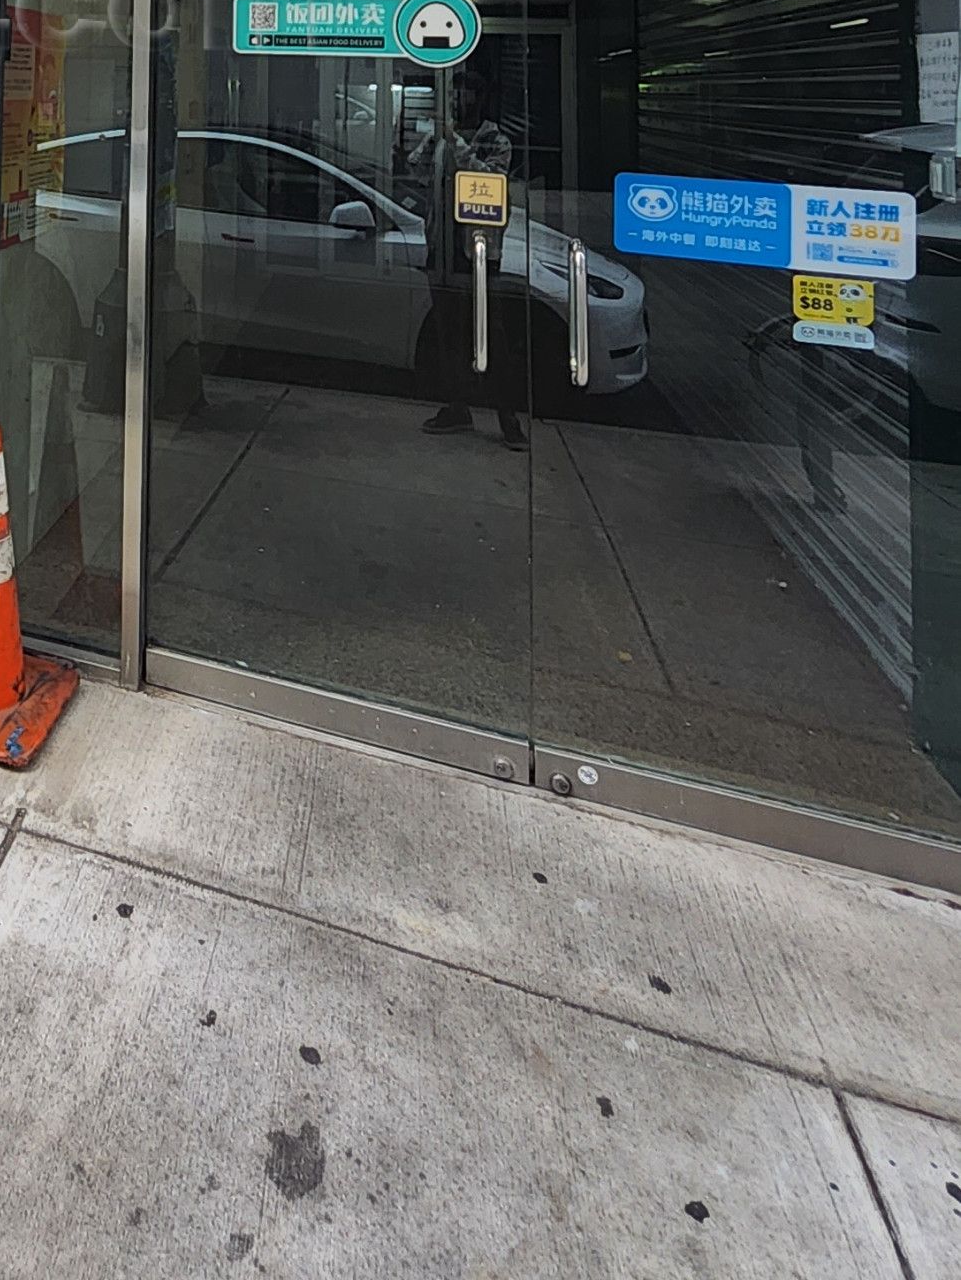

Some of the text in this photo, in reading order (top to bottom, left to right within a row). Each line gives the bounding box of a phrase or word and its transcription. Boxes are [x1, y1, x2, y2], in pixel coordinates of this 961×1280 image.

[286, 3, 385, 25] 饭团外卖
[336, 27, 385, 35] DELIVERY
[275, 37, 383, 47] THE BEST ASIAN FOOD DELIVERY
[469, 180, 493, 198] 拉
[463, 203, 497, 215] PULL
[680, 190, 778, 219] 熊猫外卖
[806, 199, 900, 222] 新人注册
[681, 212, 777, 230] HungryPanda
[800, 296, 834, 311] $88
